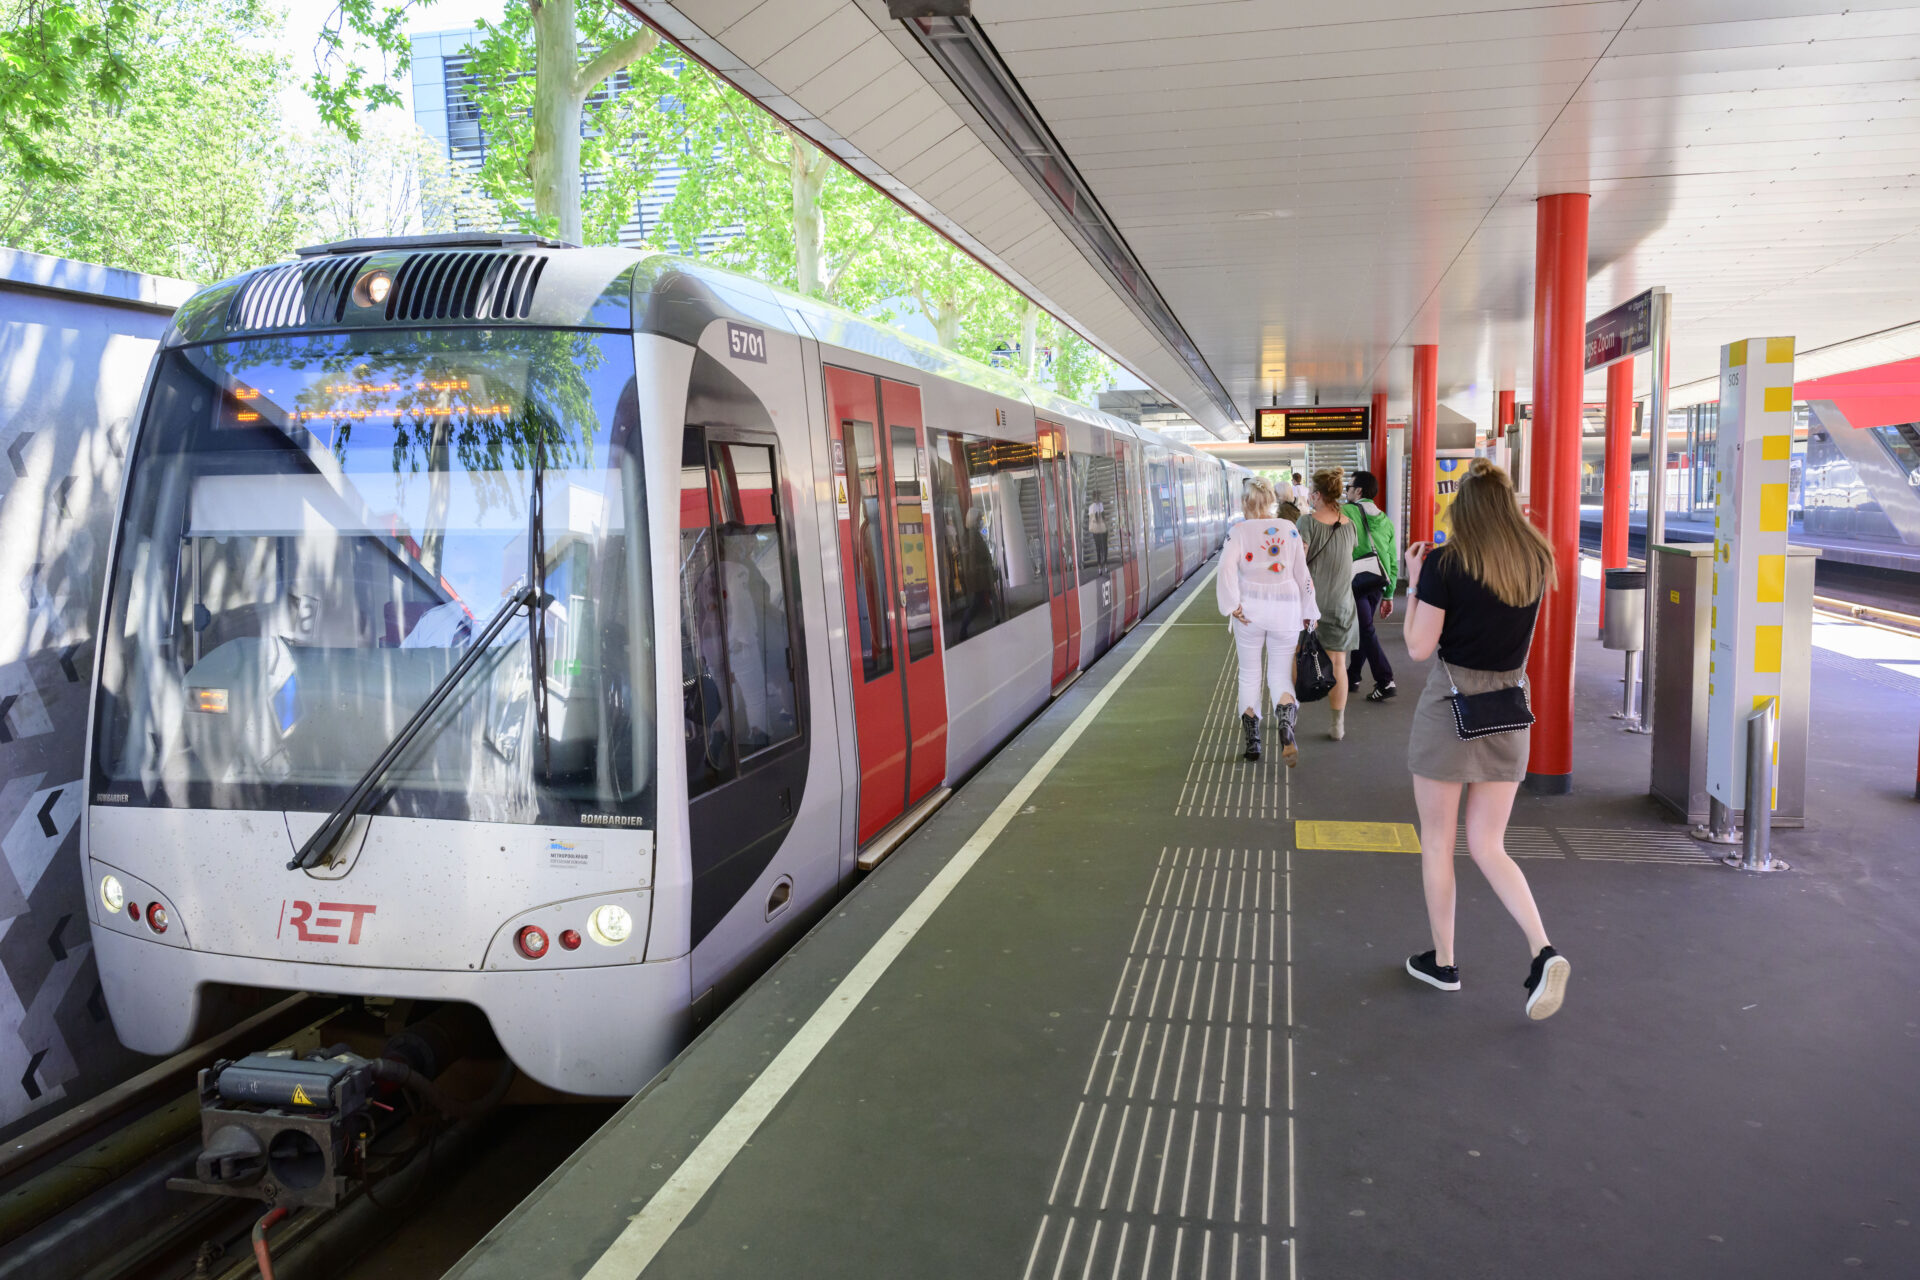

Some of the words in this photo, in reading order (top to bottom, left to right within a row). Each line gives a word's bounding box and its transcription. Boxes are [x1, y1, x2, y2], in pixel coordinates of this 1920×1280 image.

[731, 329, 764, 357] 5701
[1598, 332, 1615, 353] Zoom
[1729, 372, 1739, 387] SOS
[581, 814, 643, 826] BOMBARDIER
[290, 900, 376, 945] RET
